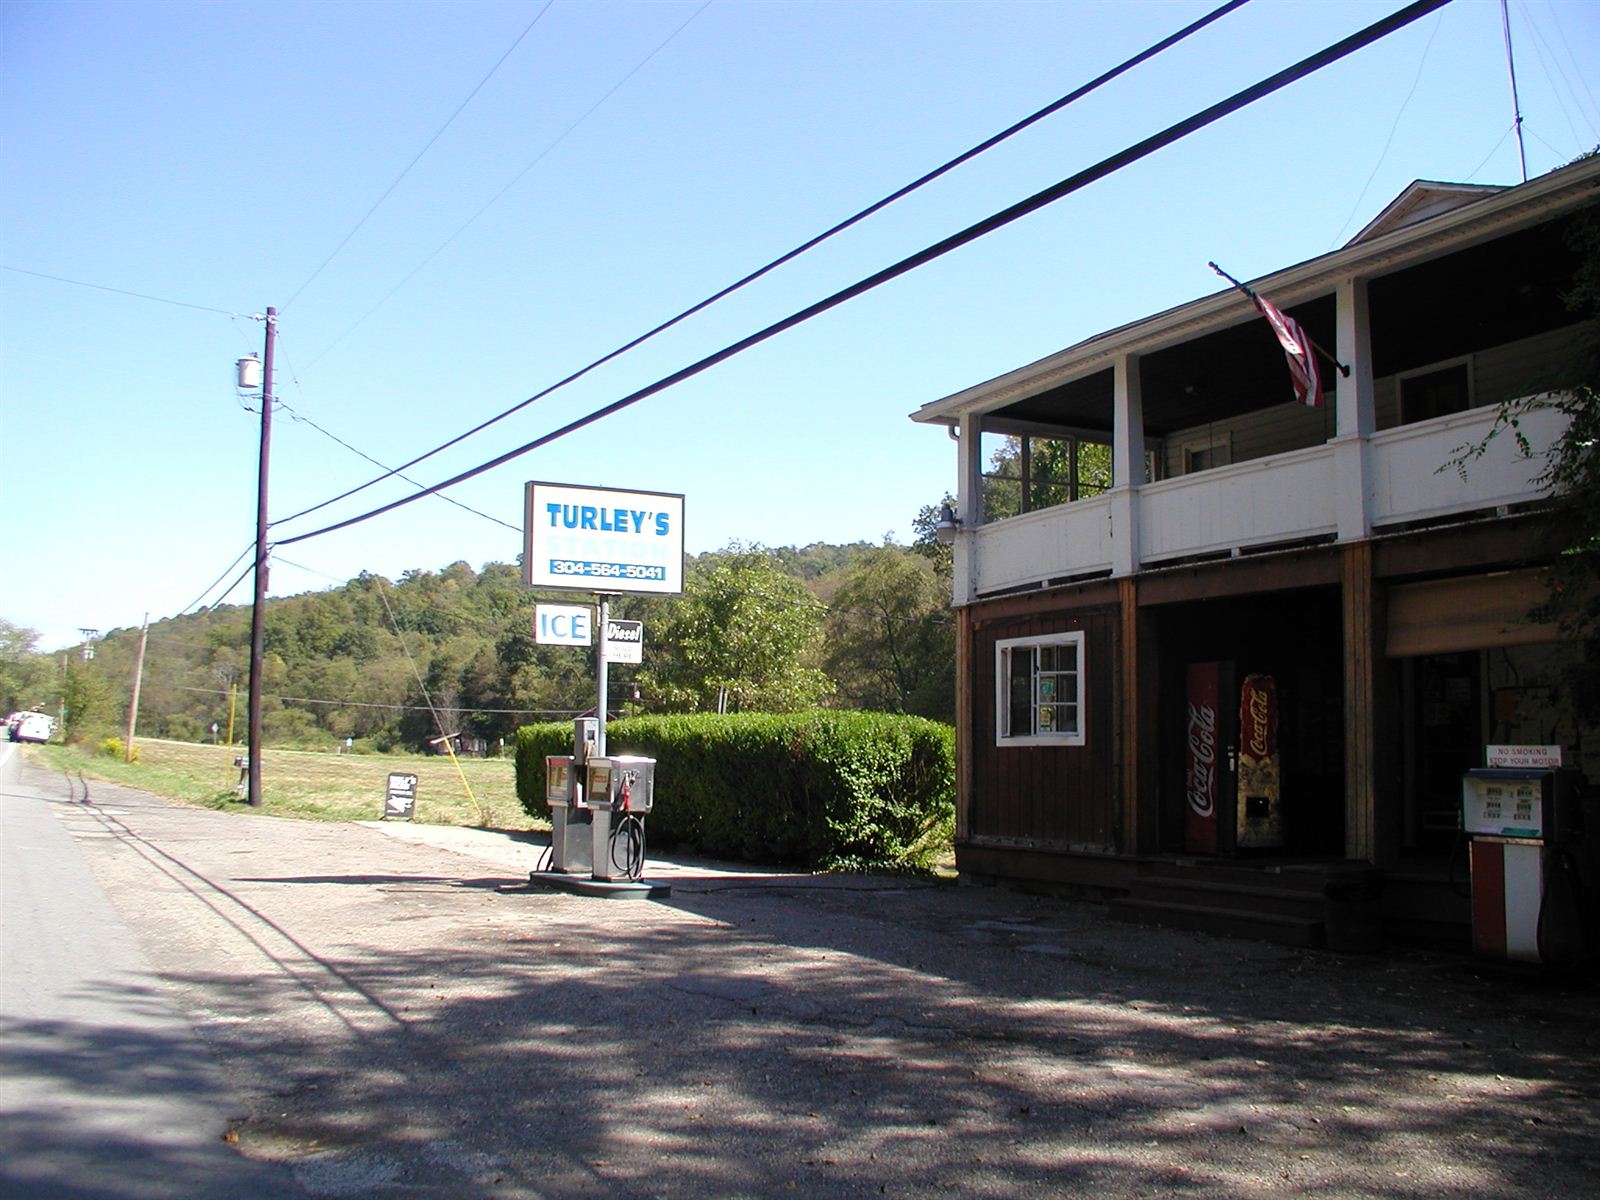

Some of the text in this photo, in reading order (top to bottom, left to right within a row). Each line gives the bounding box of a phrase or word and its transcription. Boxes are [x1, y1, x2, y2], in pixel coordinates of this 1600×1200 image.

[547, 503, 669, 536] TURLEY'S
[545, 535, 668, 560] STATION
[541, 613, 586, 639] ICE
[607, 623, 640, 640] Diesel
[1510, 757, 1529, 765] YOUR
[1532, 757, 1559, 765] MOTOR
